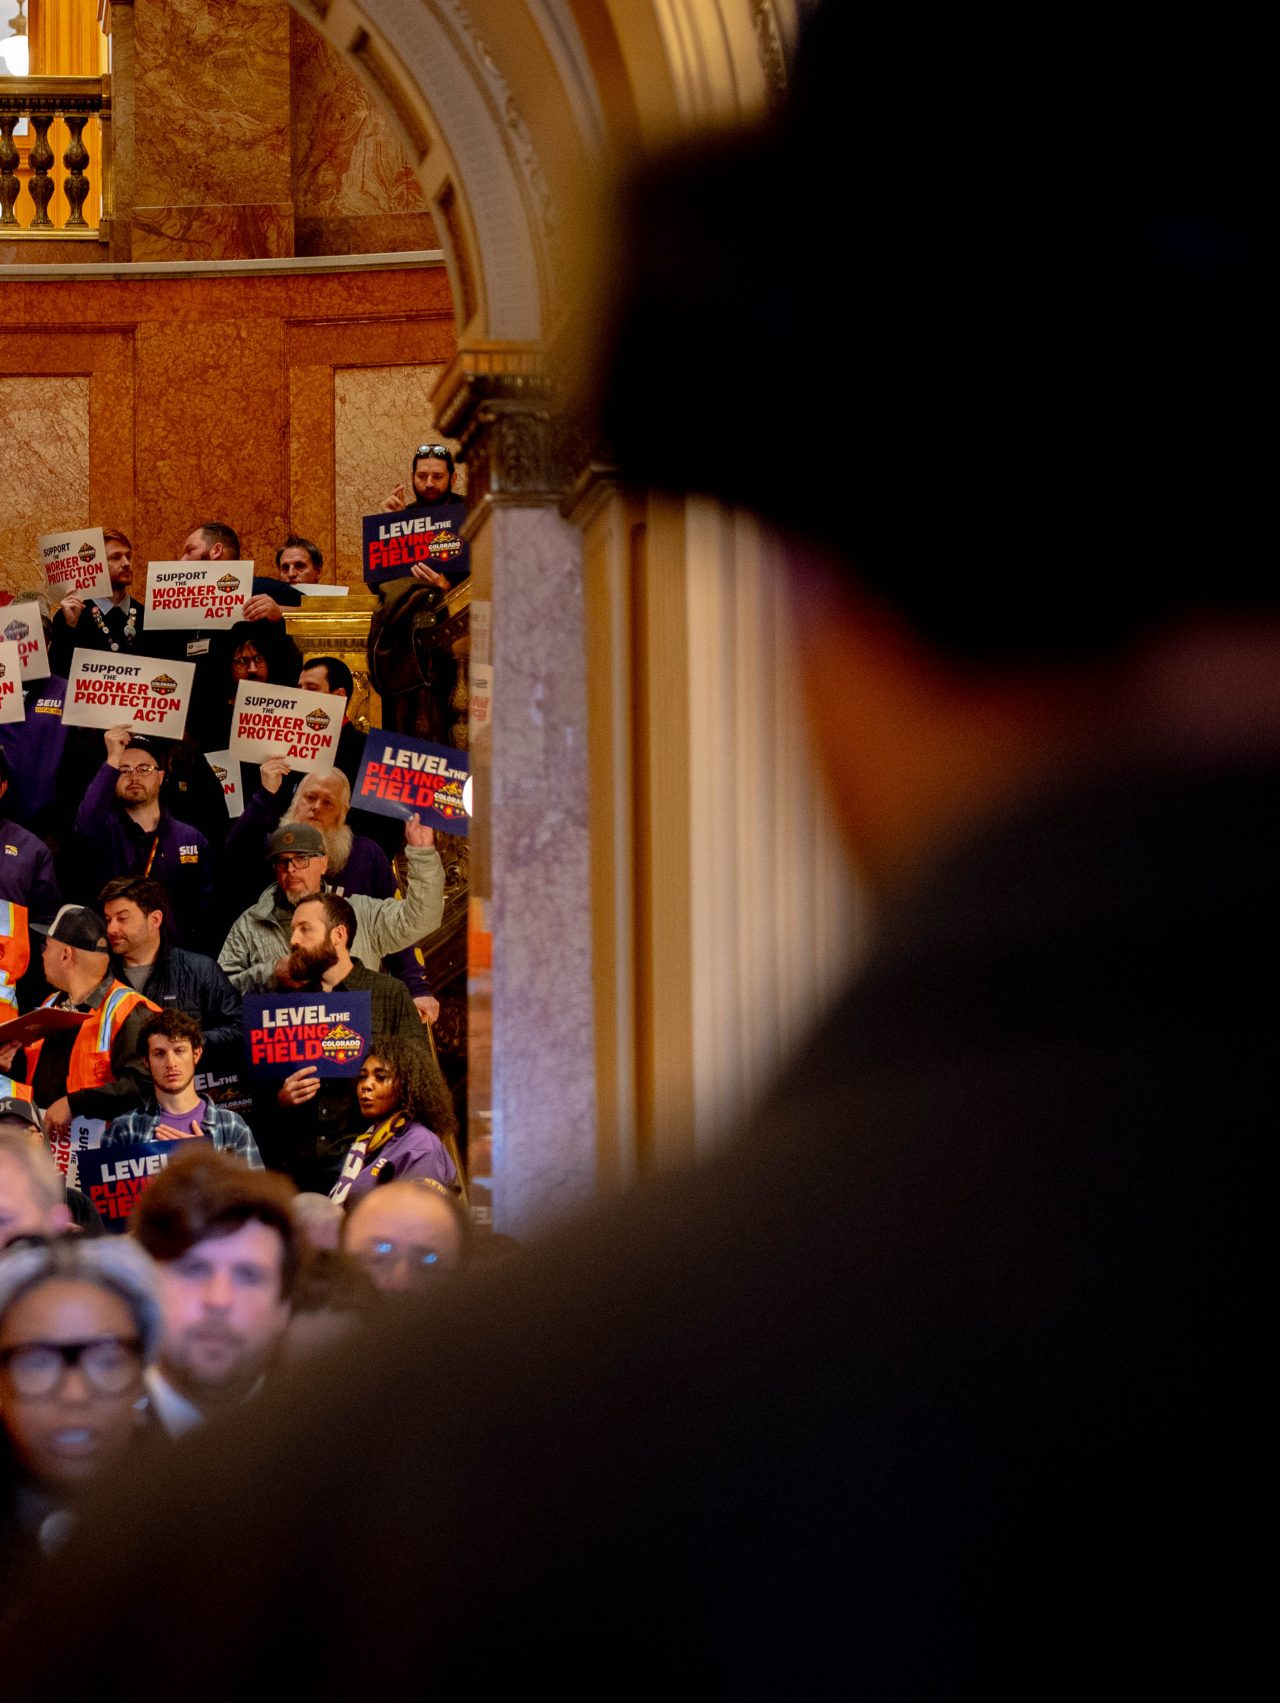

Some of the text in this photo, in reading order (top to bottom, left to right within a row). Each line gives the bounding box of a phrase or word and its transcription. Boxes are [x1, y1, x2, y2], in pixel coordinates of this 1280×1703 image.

[379, 516, 451, 540] LEVEL THE
[43, 543, 70, 557] SUPPORT
[369, 531, 436, 554] PLAYING
[428, 541, 461, 551] COLORADO
[44, 556, 79, 574] WORKER
[369, 544, 430, 570] FIELD
[47, 562, 104, 586] PROTECTION
[75, 576, 97, 590] ACT
[156, 571, 208, 583] SUPPORT
[152, 585, 216, 600] WORKER
[152, 594, 245, 611] PROTECTION
[204, 606, 234, 619] ACT
[81, 663, 142, 677] SUPPORT
[75, 679, 150, 696] WORKER
[36, 698, 62, 708] SEIU
[74, 691, 181, 711] PROTECTION
[244, 696, 298, 710] SUPPORT
[133, 709, 168, 723] ACT
[239, 713, 304, 731] WORKER
[237, 726, 333, 748] PROTECTION
[286, 745, 320, 760] ACT
[382, 746, 468, 781] LEVEL THE
[366, 761, 447, 790] PLAYING
[361, 775, 435, 808] FIELD
[434, 792, 464, 805] COLORA
[262, 1005, 351, 1028] LEVEL THE
[250, 1024, 329, 1044] PLAYING
[251, 1040, 322, 1065] FIELD
[219, 1074, 238, 1085] THE
[90, 1177, 152, 1200] PLAY
[95, 1195, 141, 1219] FIE
